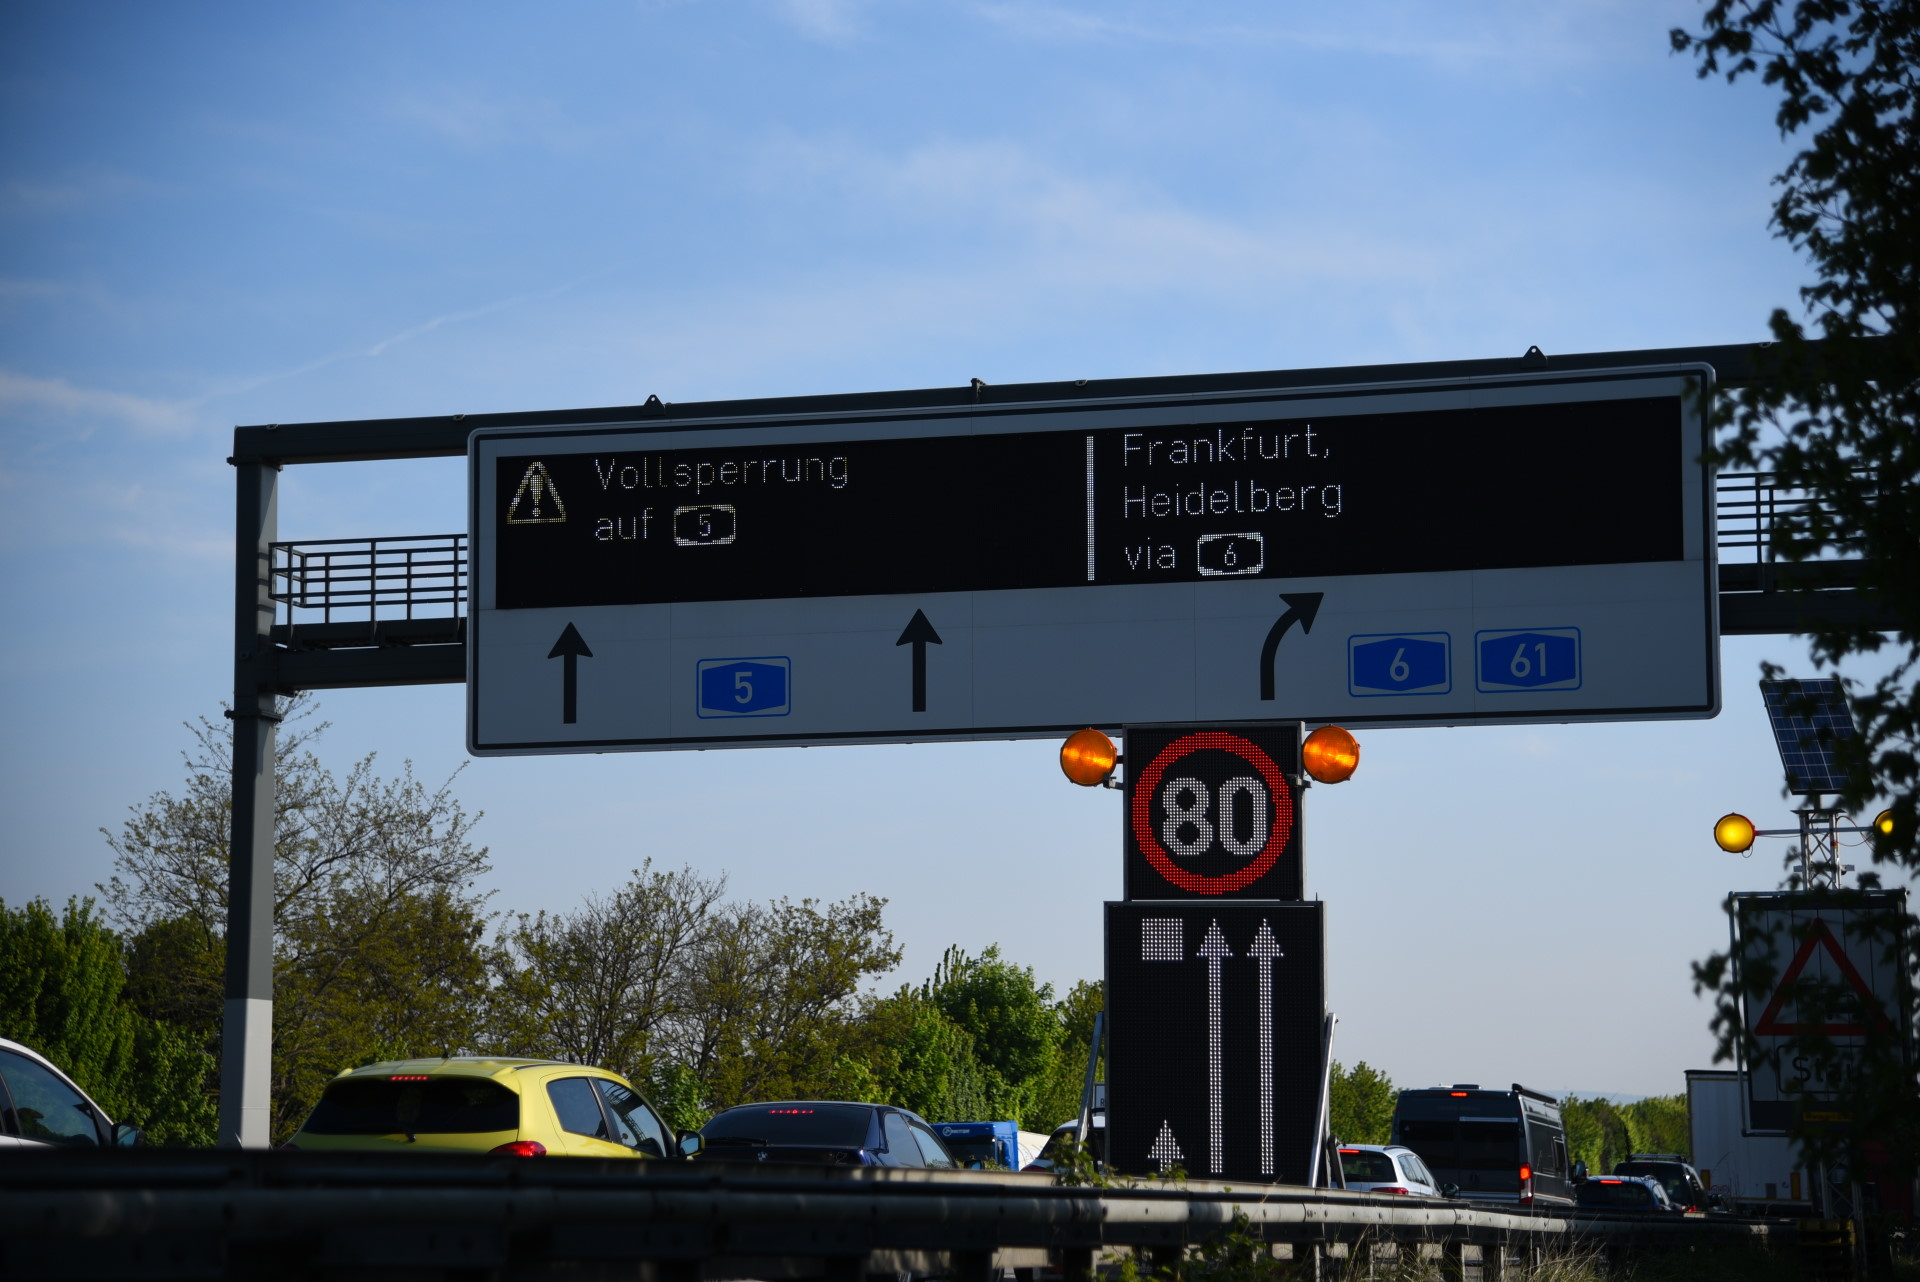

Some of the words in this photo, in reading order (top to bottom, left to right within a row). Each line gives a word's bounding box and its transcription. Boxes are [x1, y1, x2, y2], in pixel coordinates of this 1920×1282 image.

[1124, 424, 1330, 467] Frankfurt,
[595, 456, 848, 495] Vollsperrung
[1124, 479, 1342, 519] Heidelberg
[595, 508, 653, 541] auf
[699, 513, 711, 537] 5
[1125, 537, 1176, 570] via
[1224, 542, 1237, 567] 6
[1389, 647, 1410, 682] 6
[1510, 642, 1549, 678] 61
[734, 671, 753, 704] 5
[1162, 776, 1267, 856] 80
